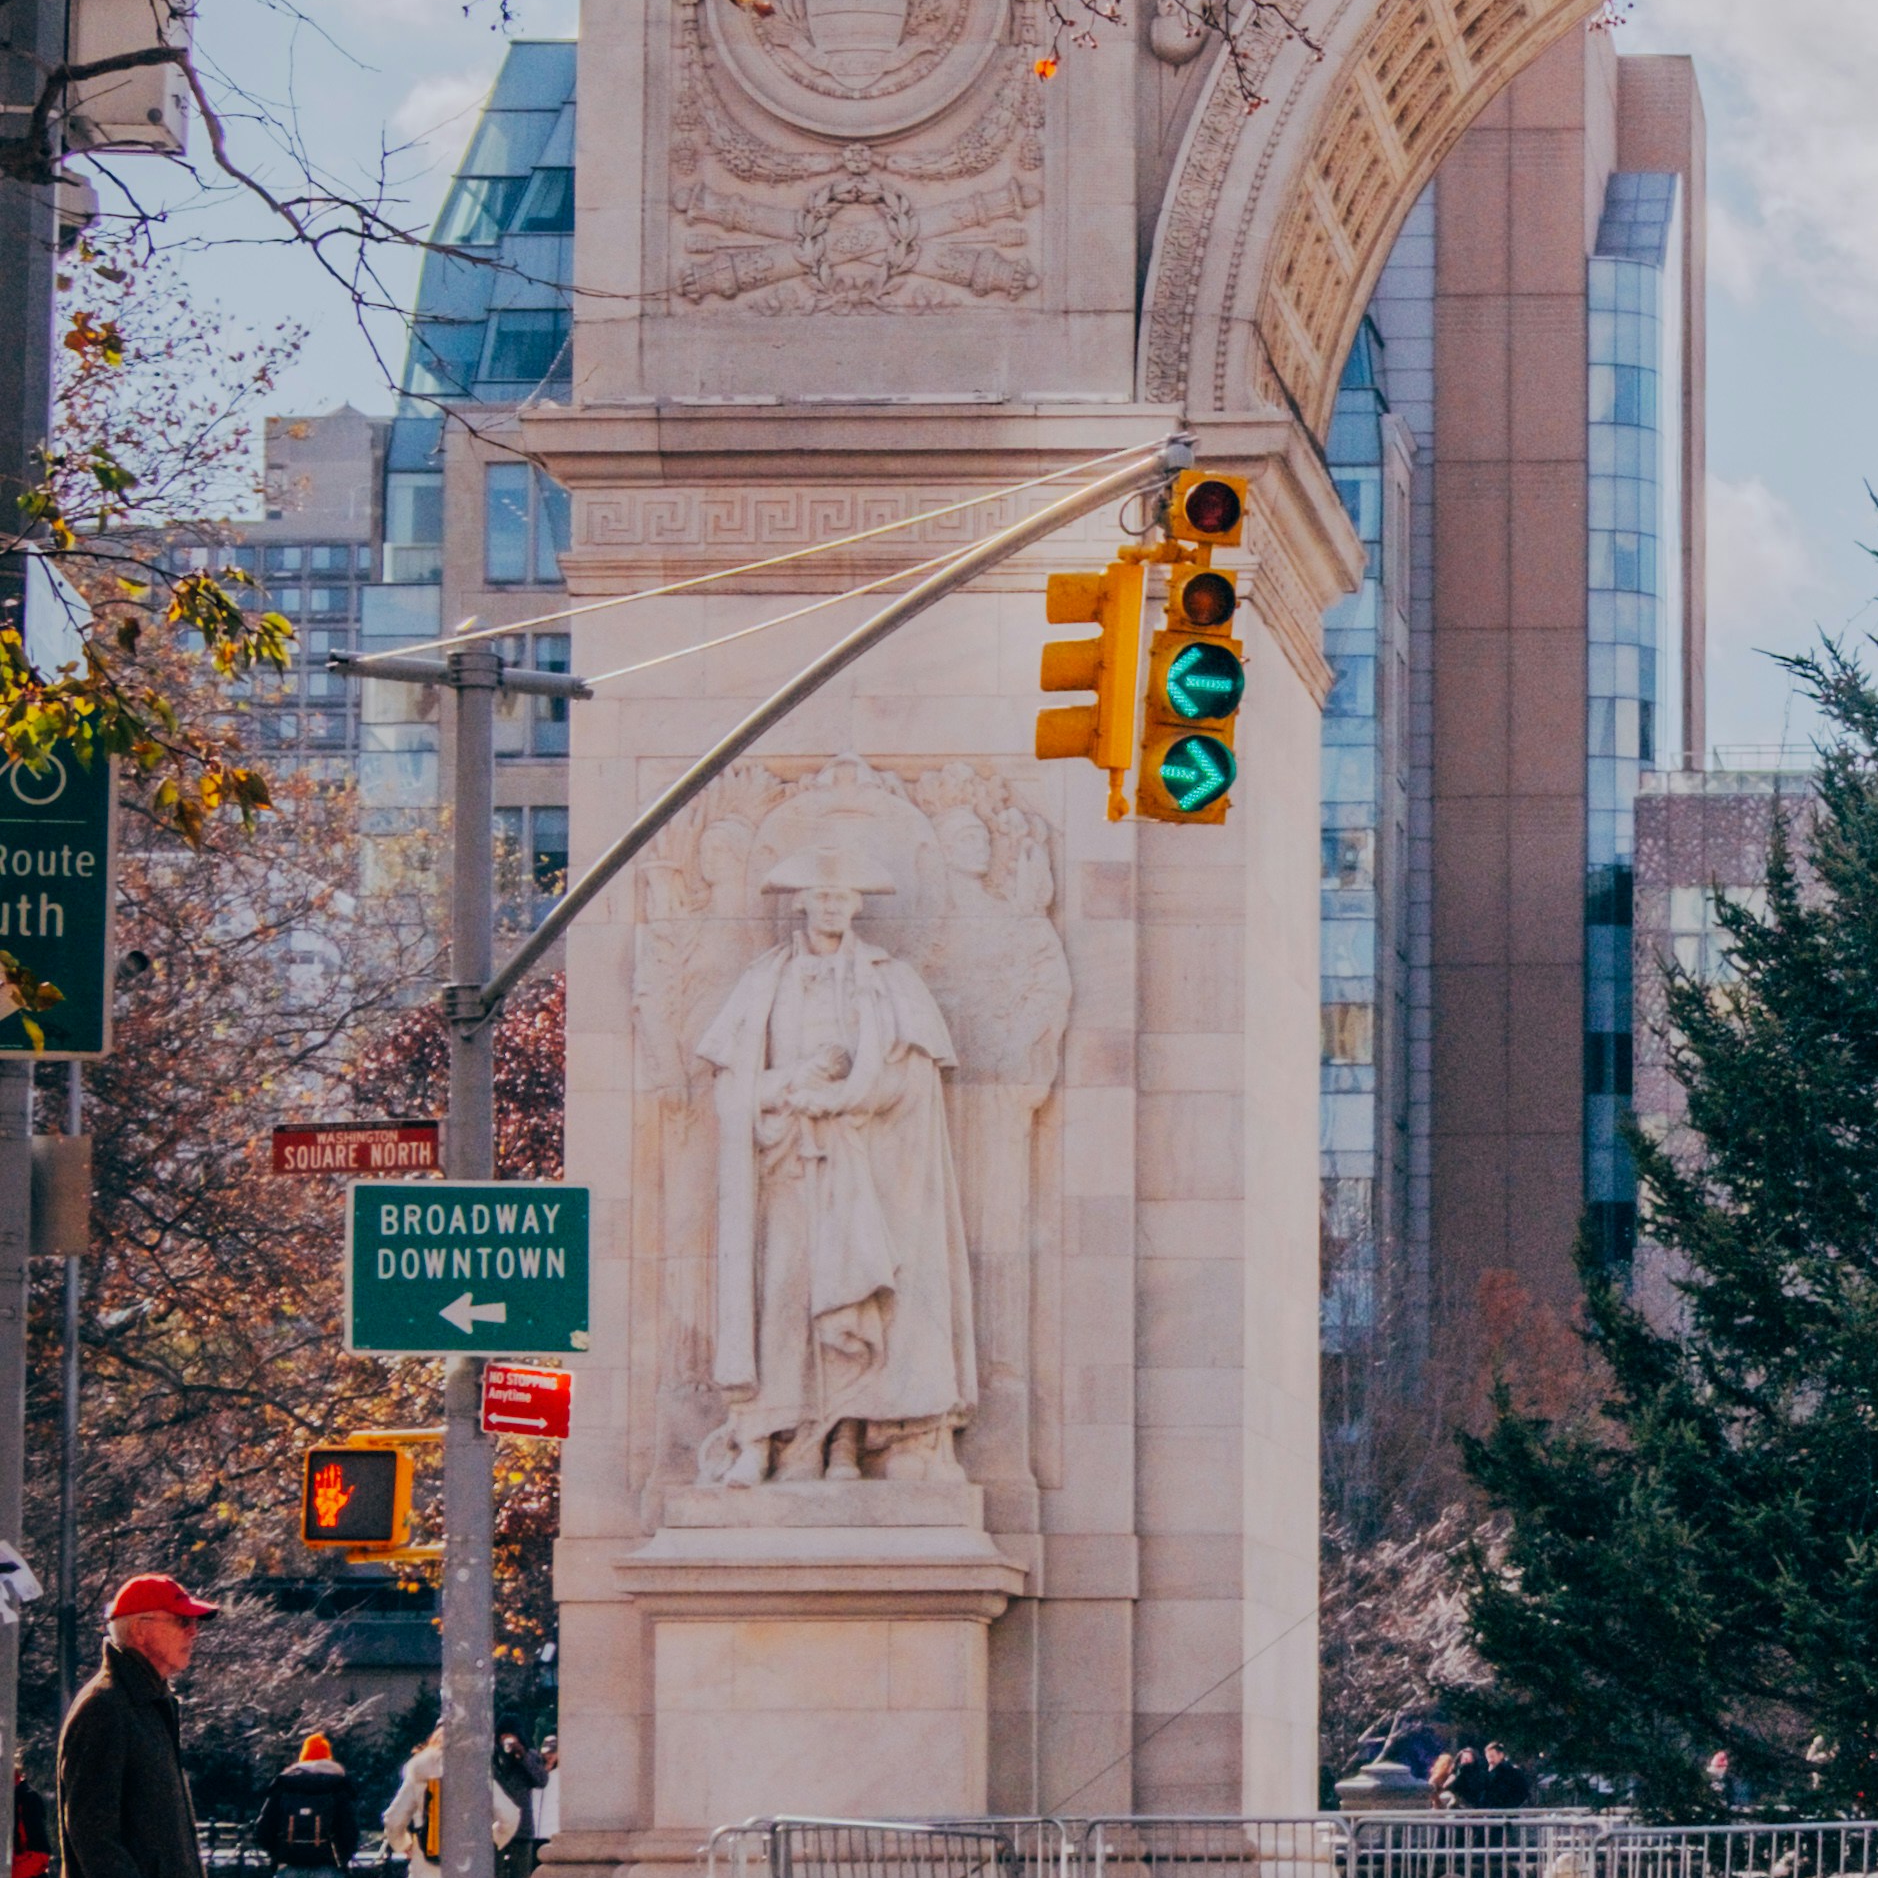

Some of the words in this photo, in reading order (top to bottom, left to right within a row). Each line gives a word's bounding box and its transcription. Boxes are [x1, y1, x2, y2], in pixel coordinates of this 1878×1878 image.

[315, 1129, 399, 1145] WASHINGTON
[283, 1143, 360, 1171] SQUARE
[370, 1141, 432, 1168] NORTH
[380, 1203, 561, 1236] BROADWAY
[377, 1247, 566, 1280] DOWNTOWN
[488, 1370, 505, 1385] NO
[488, 1386, 532, 1403] Anytime
